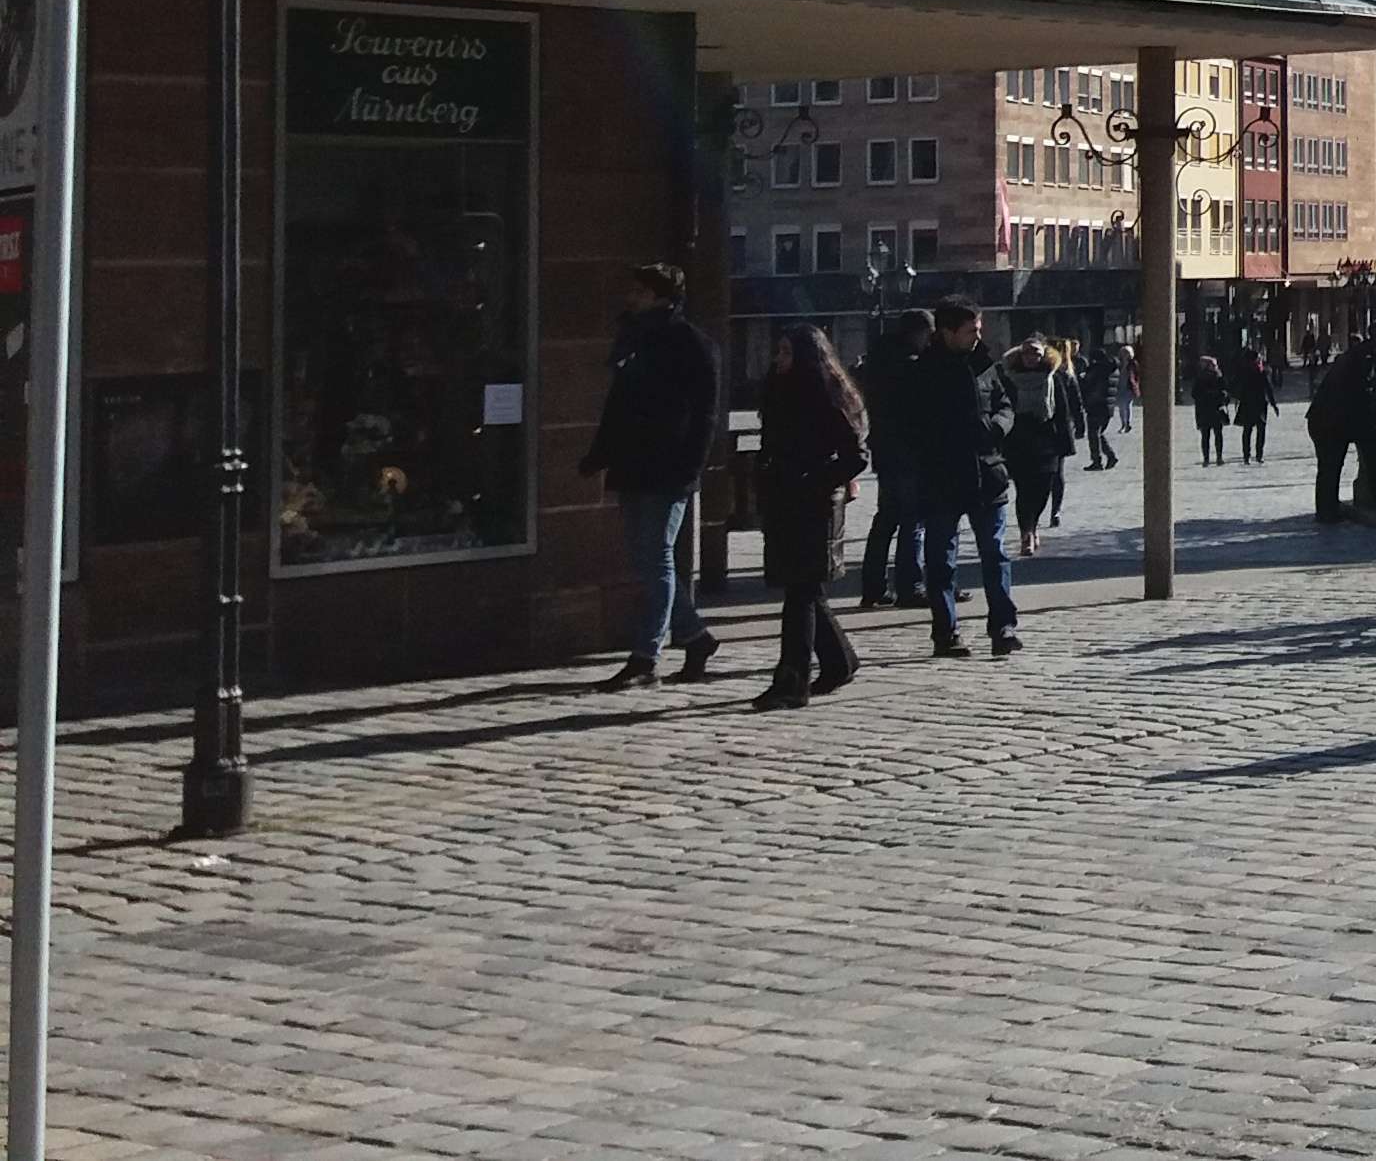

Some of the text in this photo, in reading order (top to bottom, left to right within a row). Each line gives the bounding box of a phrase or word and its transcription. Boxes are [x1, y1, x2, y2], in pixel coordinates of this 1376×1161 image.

[330, 18, 487, 60] Souvenirs
[382, 64, 438, 86] aus
[335, 87, 480, 133] Nürnberg
